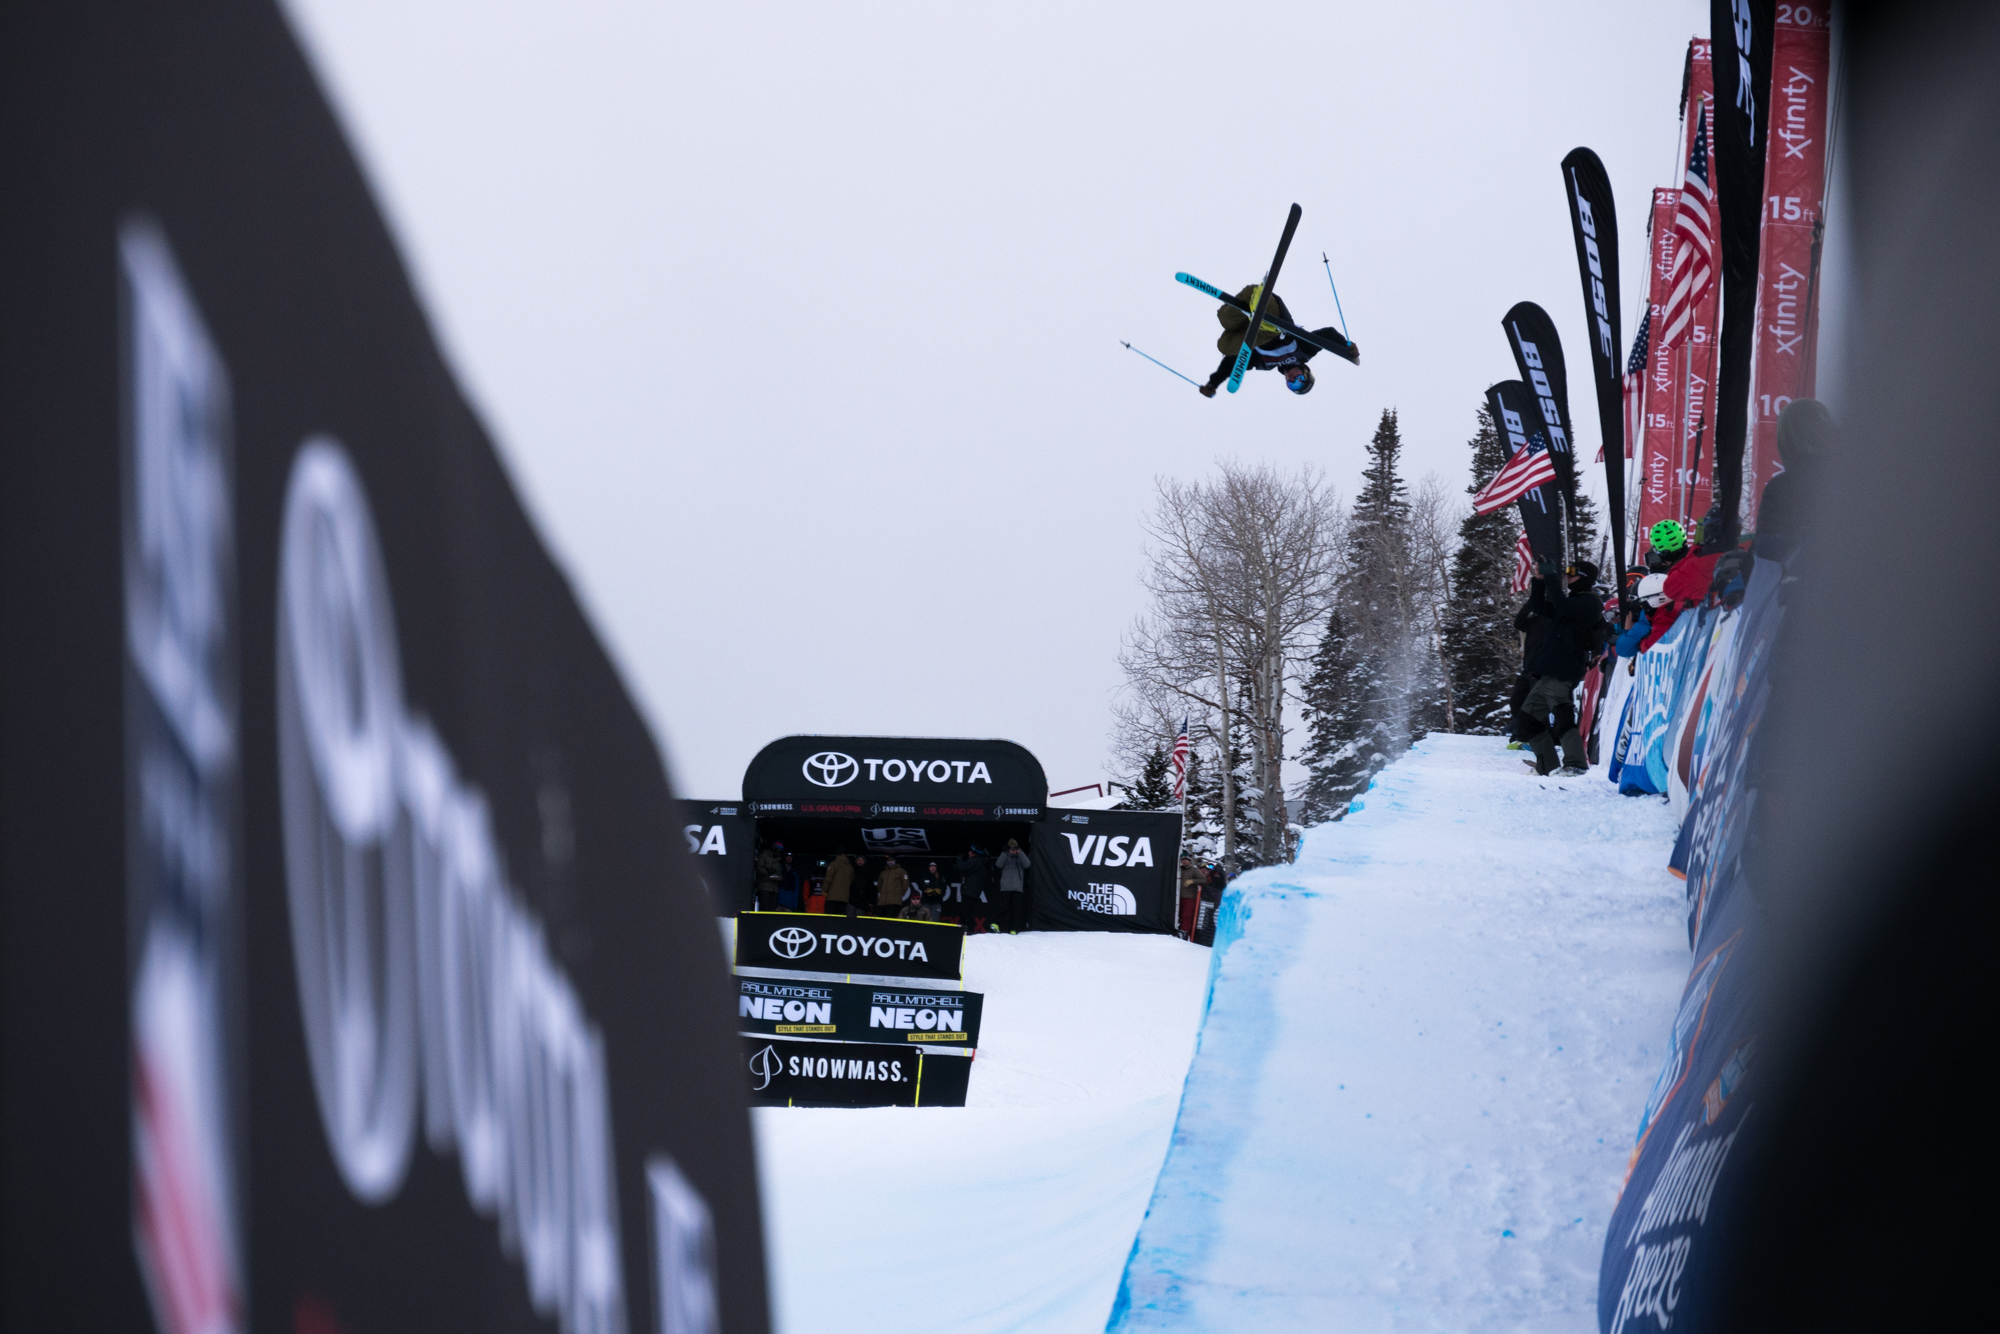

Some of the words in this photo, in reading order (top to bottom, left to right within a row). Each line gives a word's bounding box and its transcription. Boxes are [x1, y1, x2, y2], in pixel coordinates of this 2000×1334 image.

[1778, 66, 1814, 159] xfinity
[1656, 228, 1678, 281] xfinity
[1185, 275, 1218, 296] MOMENT
[1571, 166, 1614, 379] BOSE
[1769, 262, 1805, 355] xfinity
[1233, 348, 1250, 385] MOMENT
[1652, 340, 1672, 393] xfinity
[1512, 321, 1569, 453] BOSE
[1647, 451, 1669, 504] xfinity
[864, 758, 992, 784] TOYOTA
[816, 805, 843, 813] GRAND
[844, 805, 861, 813] PRIX
[939, 808, 966, 816] GRAND
[967, 808, 984, 816] PRIX
[863, 828, 923, 843] US
[1060, 832, 1154, 867] VISA
[1068, 890, 1113, 905] NORTH
[1088, 882, 1113, 895] THE
[1080, 901, 1113, 915] FACE
[821, 934, 928, 963] TOYOTA
[741, 982, 772, 994] PAUL
[774, 986, 832, 999] MITCHELL
[872, 994, 904, 1004] PAUL
[906, 995, 963, 1007] MITCHELL
[739, 995, 832, 1024] NEON
[869, 1006, 963, 1031] NEON
[1626, 1101, 1754, 1249] Almond
